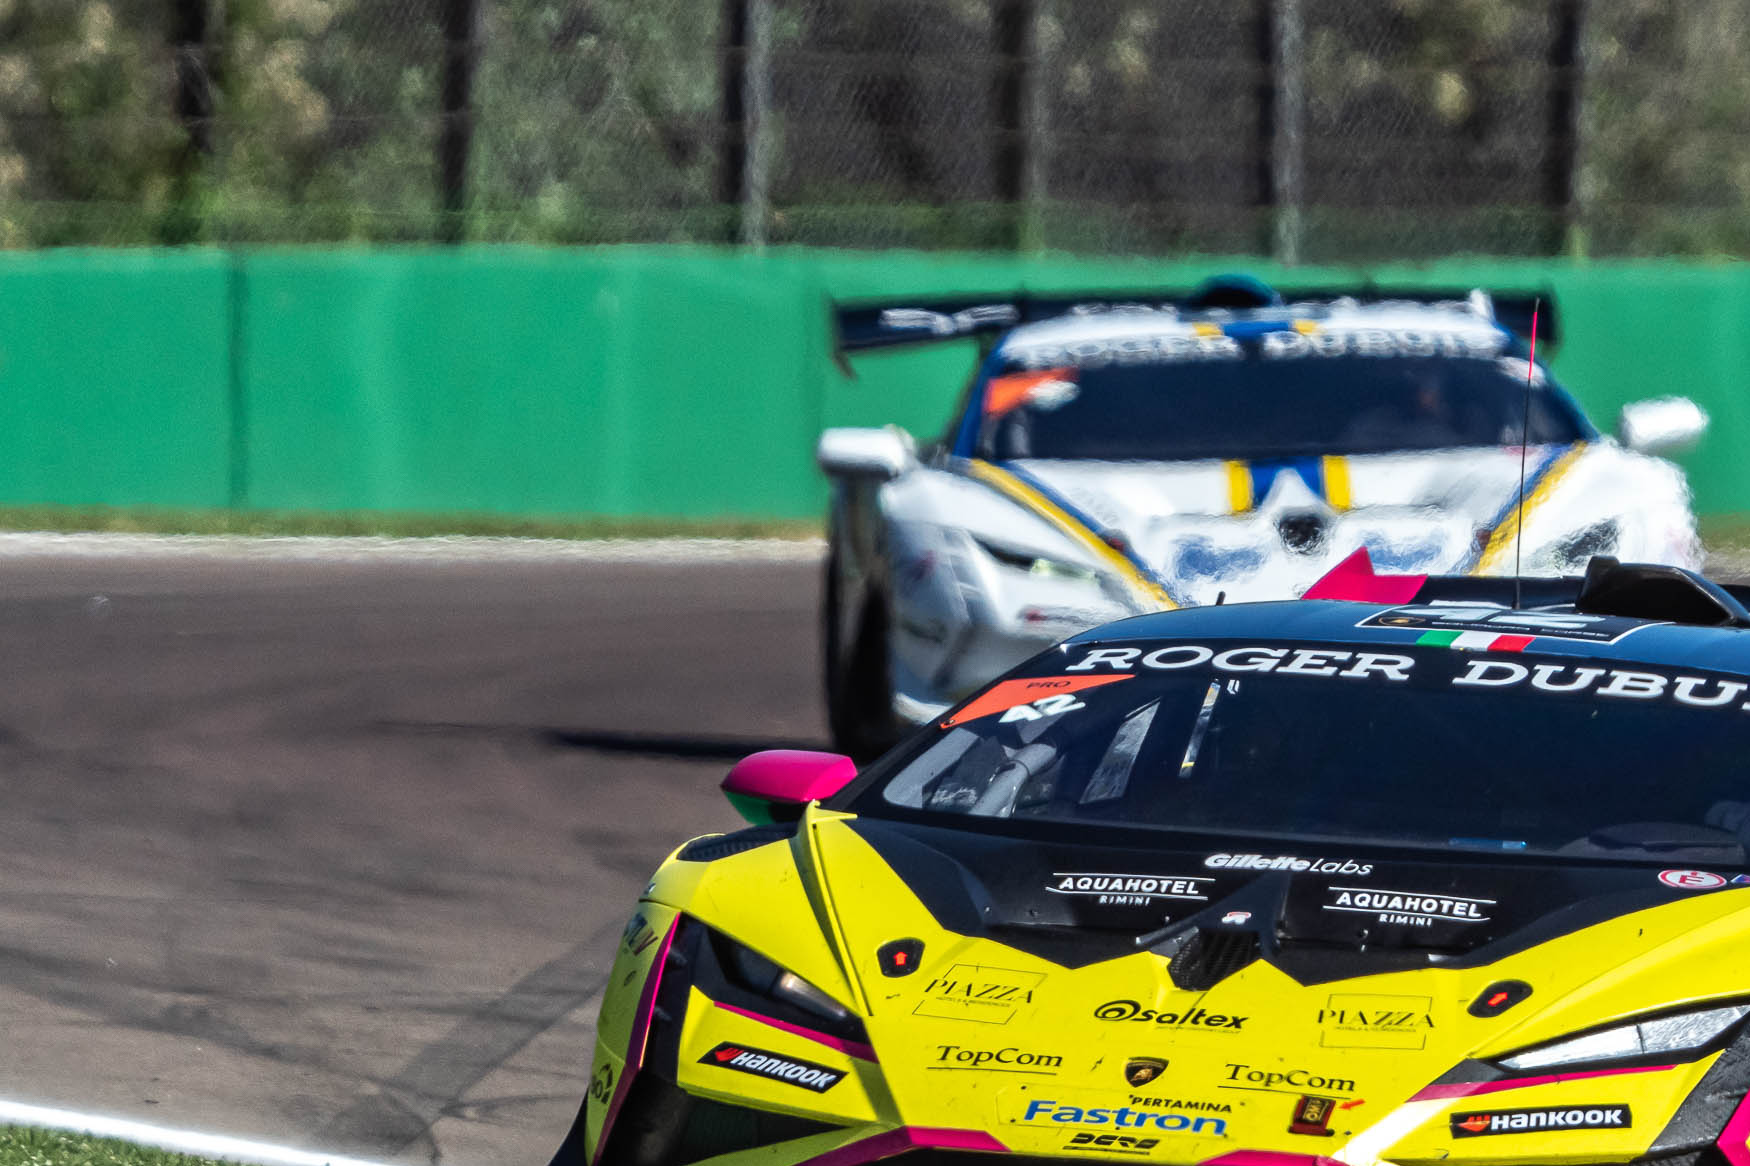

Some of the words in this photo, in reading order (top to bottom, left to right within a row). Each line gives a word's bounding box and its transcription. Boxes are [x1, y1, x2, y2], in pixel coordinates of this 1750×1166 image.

[1065, 645, 1416, 681] ROGER
[1027, 680, 1071, 688] PRO
[1058, 877, 1200, 895] AQUAHOTEL
[1099, 895, 1151, 906] RIMINI
[1335, 890, 1482, 918] AQUAHOTEL
[1378, 913, 1433, 926] RIMINI
[924, 979, 1033, 1003] PIAZZA
[1317, 1009, 1435, 1028] PIAZZA
[936, 1044, 1064, 1068] TopCom
[1224, 1063, 1357, 1093] TopCom
[1132, 1096, 1232, 1114] PERTAMINA
[1023, 1099, 1228, 1136] Fastron
